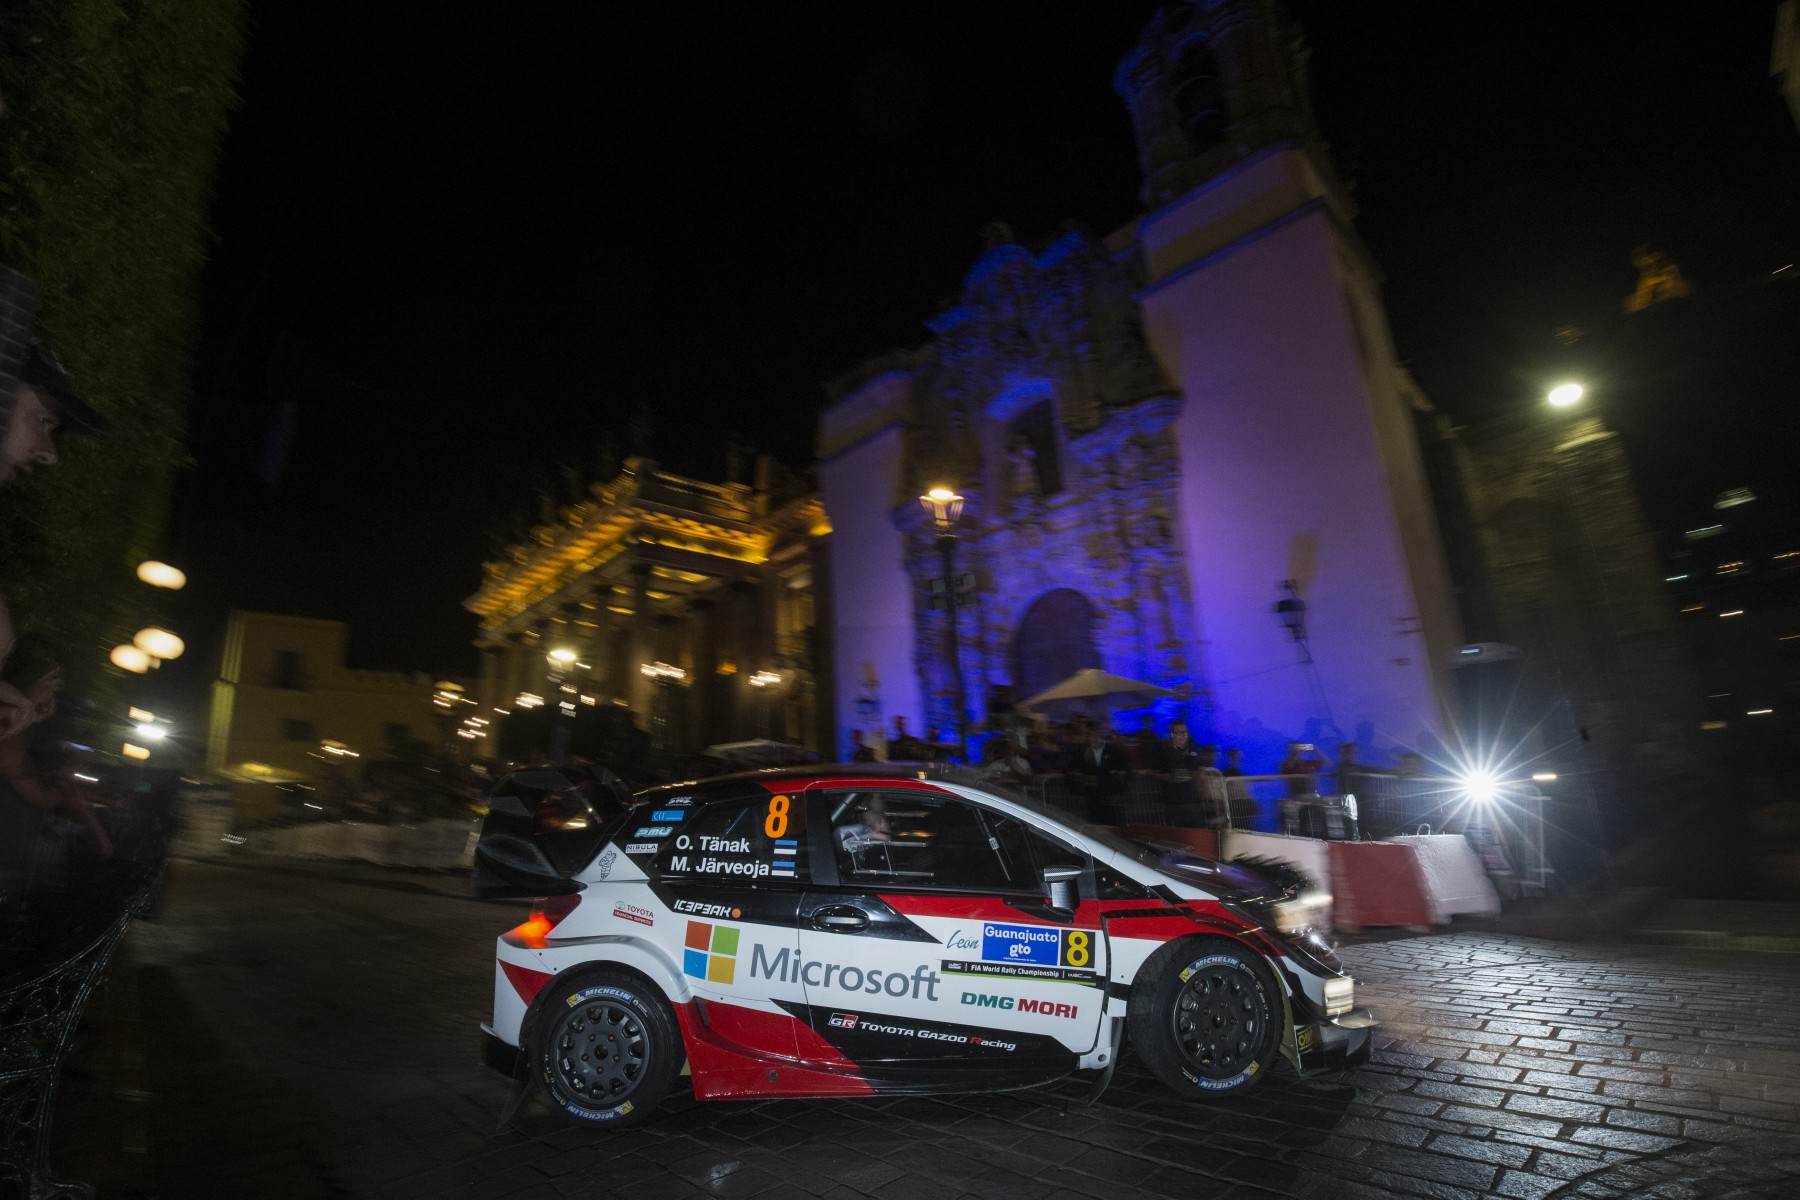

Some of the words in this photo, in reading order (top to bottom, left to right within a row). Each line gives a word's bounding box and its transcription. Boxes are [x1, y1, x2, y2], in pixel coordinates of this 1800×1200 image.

[764, 795, 790, 839] 8
[676, 834, 693, 850] O.
[700, 836, 750, 853] Tänak
[670, 856, 691, 872] M.
[696, 858, 769, 879] Järveoja
[627, 904, 654, 918] TOYOTA
[946, 929, 980, 950] León
[984, 925, 1058, 944] Guanajuato
[1009, 943, 1031, 957] gto
[1066, 930, 1089, 967] 8
[1195, 956, 1238, 968] MICHELIN
[750, 943, 941, 1002] Microsoft
[970, 964, 982, 972] FIA
[982, 965, 1000, 973] World
[1001, 967, 1017, 975] Rally
[1017, 968, 1060, 978] Championship
[585, 988, 631, 1001] MICHELIN
[960, 991, 1015, 1010] DMG
[1017, 998, 1078, 1020] MORI
[830, 1017, 855, 1028] GR
[969, 1037, 1017, 1051] Racing
[1200, 1074, 1245, 1089] MICHELIN
[567, 1104, 615, 1120] MICHELIN
